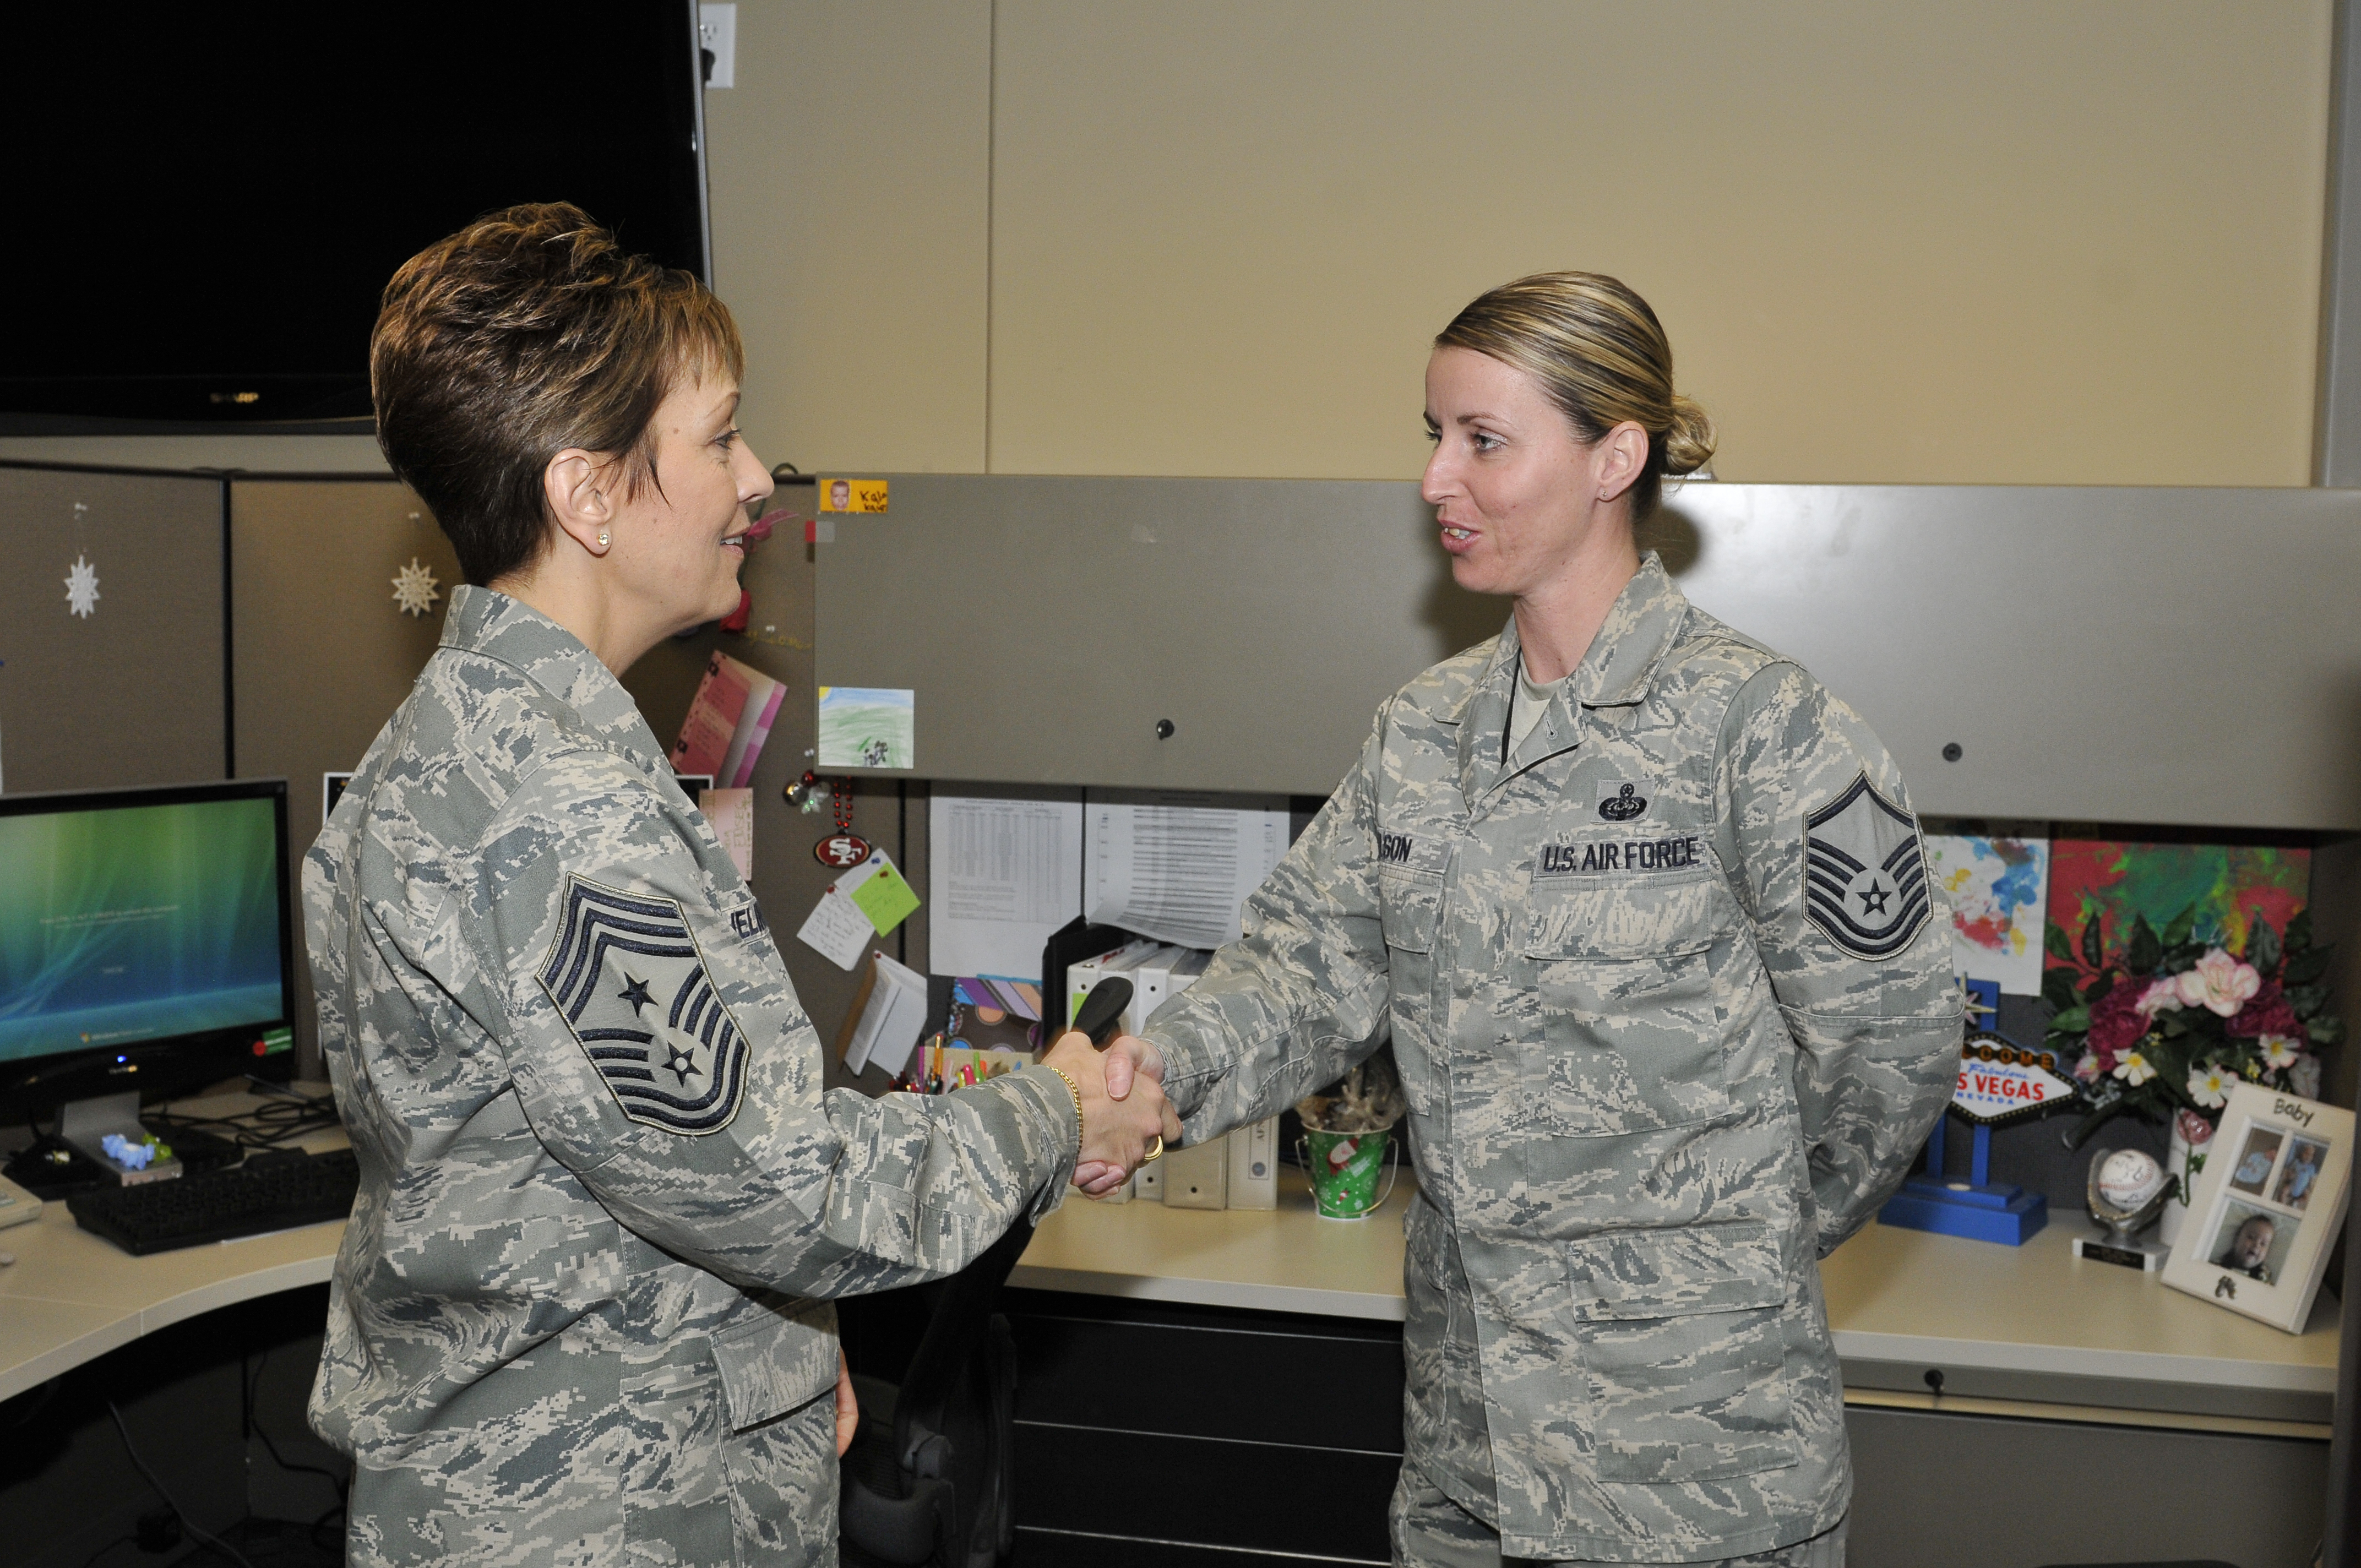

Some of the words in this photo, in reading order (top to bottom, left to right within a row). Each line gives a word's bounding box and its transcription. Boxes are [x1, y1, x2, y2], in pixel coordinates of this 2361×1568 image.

[829, 837, 862, 864] SF
[1379, 834, 1413, 863] SON
[1543, 846, 1577, 872] U.S.
[1581, 843, 1619, 870] AIR
[1625, 836, 1701, 869] FORCE
[1975, 1074, 2044, 1101] VEGAS
[2273, 1098, 2315, 1128] Baby
